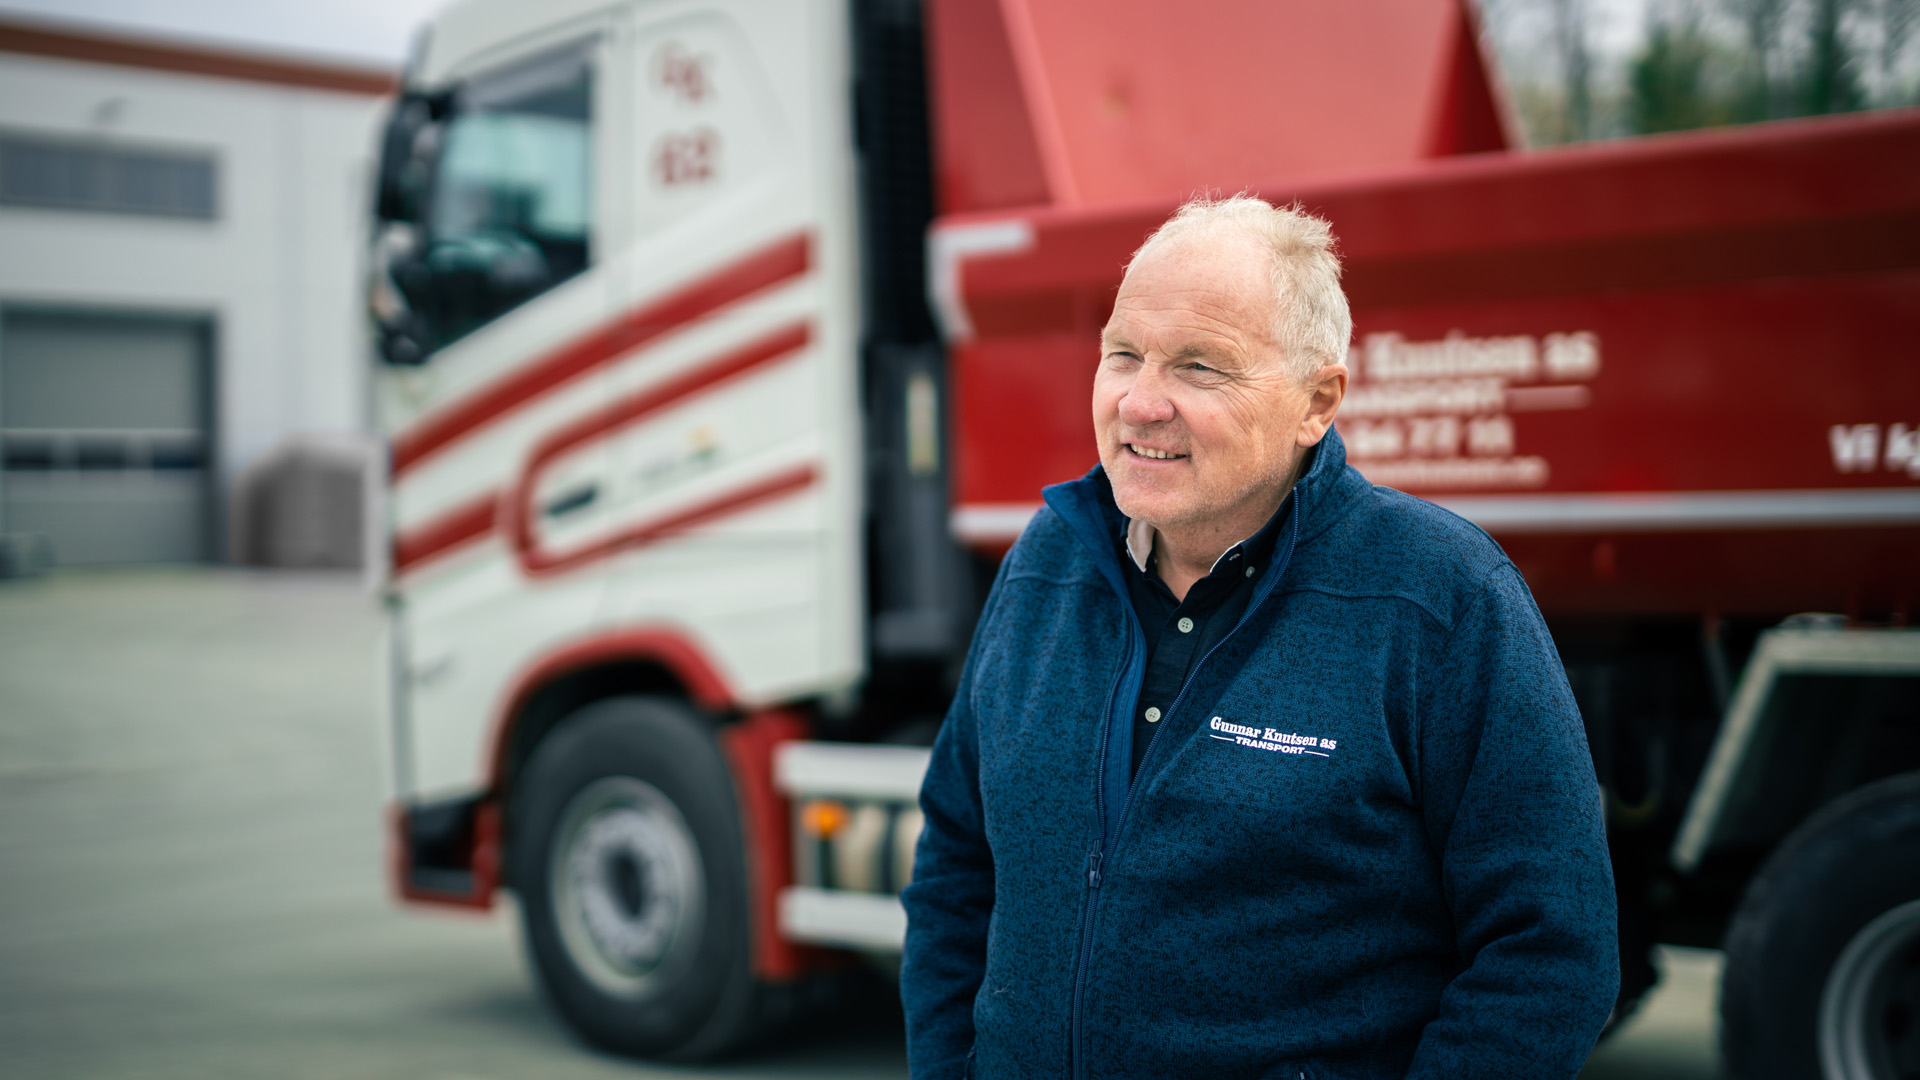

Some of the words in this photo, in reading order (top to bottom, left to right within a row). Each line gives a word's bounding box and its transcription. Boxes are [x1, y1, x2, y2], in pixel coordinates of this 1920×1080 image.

[1543, 331, 1600, 378] as
[1210, 716, 1261, 738] Gunnar
[1262, 728, 1318, 746] Knutsen
[1319, 738, 1337, 750] as
[1235, 736, 1305, 755] TRANSPORT
